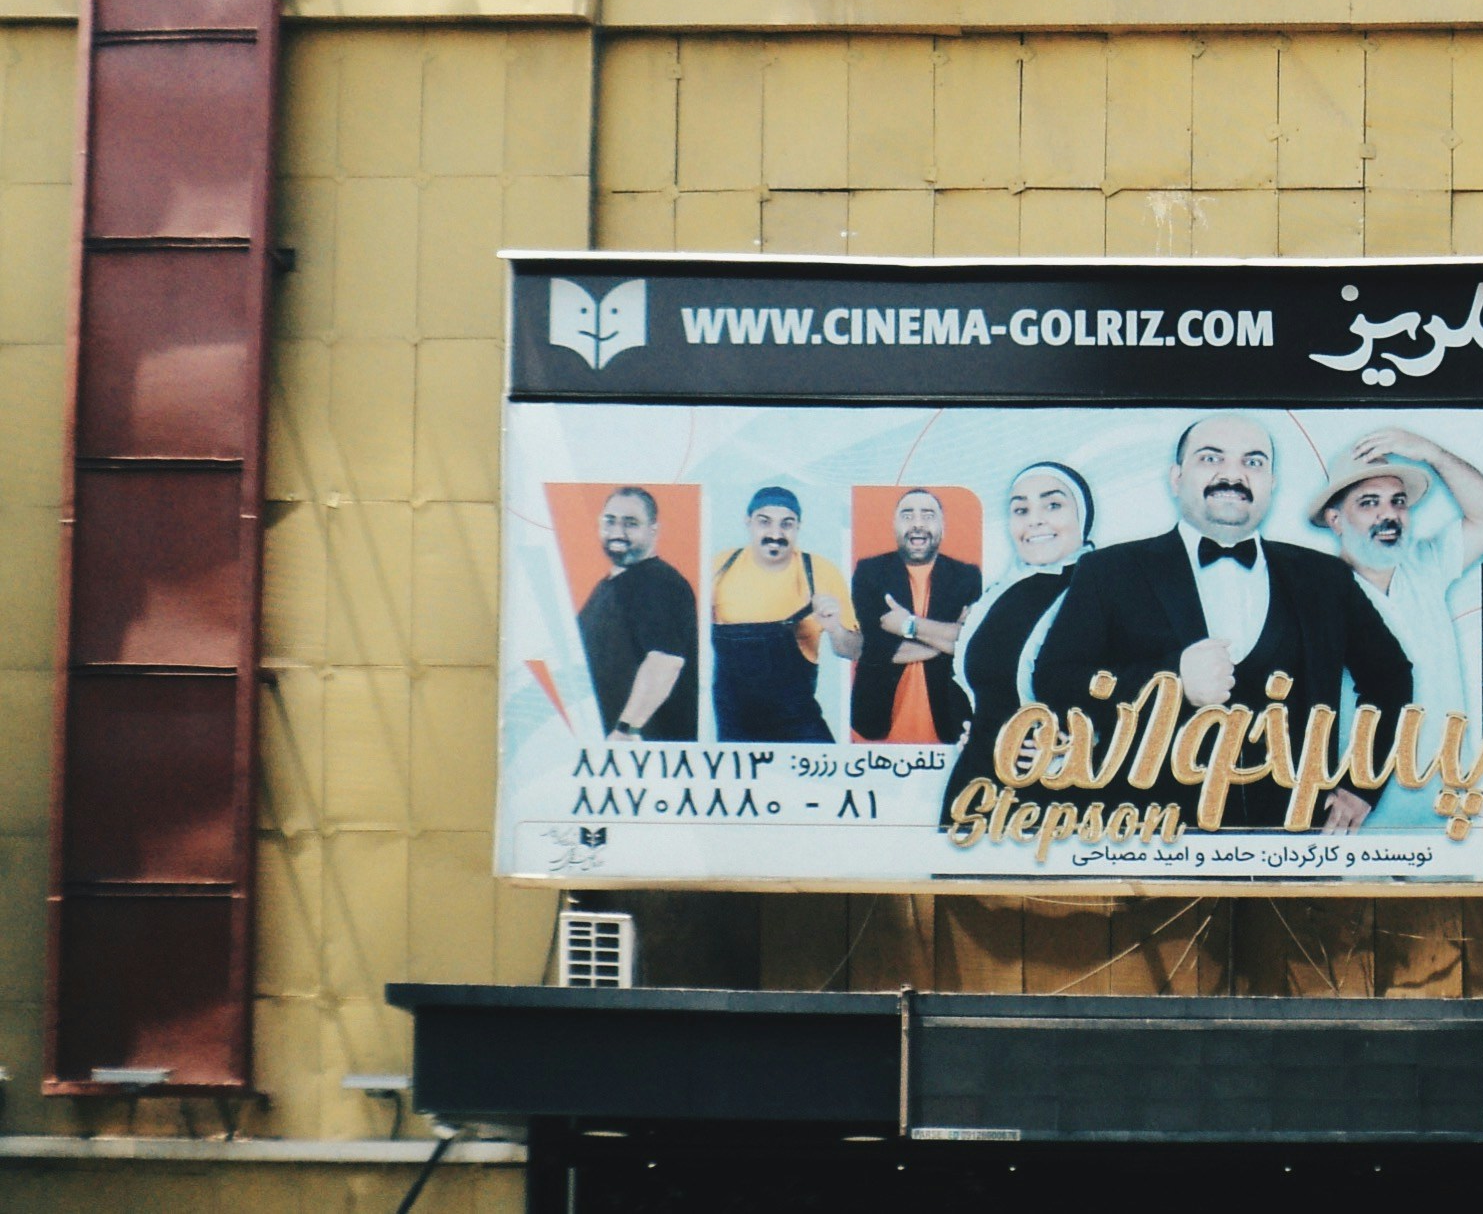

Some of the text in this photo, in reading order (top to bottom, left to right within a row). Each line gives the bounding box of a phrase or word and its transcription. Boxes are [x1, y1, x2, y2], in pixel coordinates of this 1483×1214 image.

[681, 307, 1275, 348] WWW.CINEMA-GOLRIZ.COM
[572, 747, 775, 780] ۸۸۷۱۸۷۱۳
[790, 755, 838, 778] رزرو:
[571, 786, 782, 817] ۸۸۷۰۸۸۸۰
[836, 788, 878, 819] ۸۱
[946, 776, 1187, 863] Stepson
[1072, 843, 1433, 868] نویسنده و کارگردان: حامد و امید مصباحی
